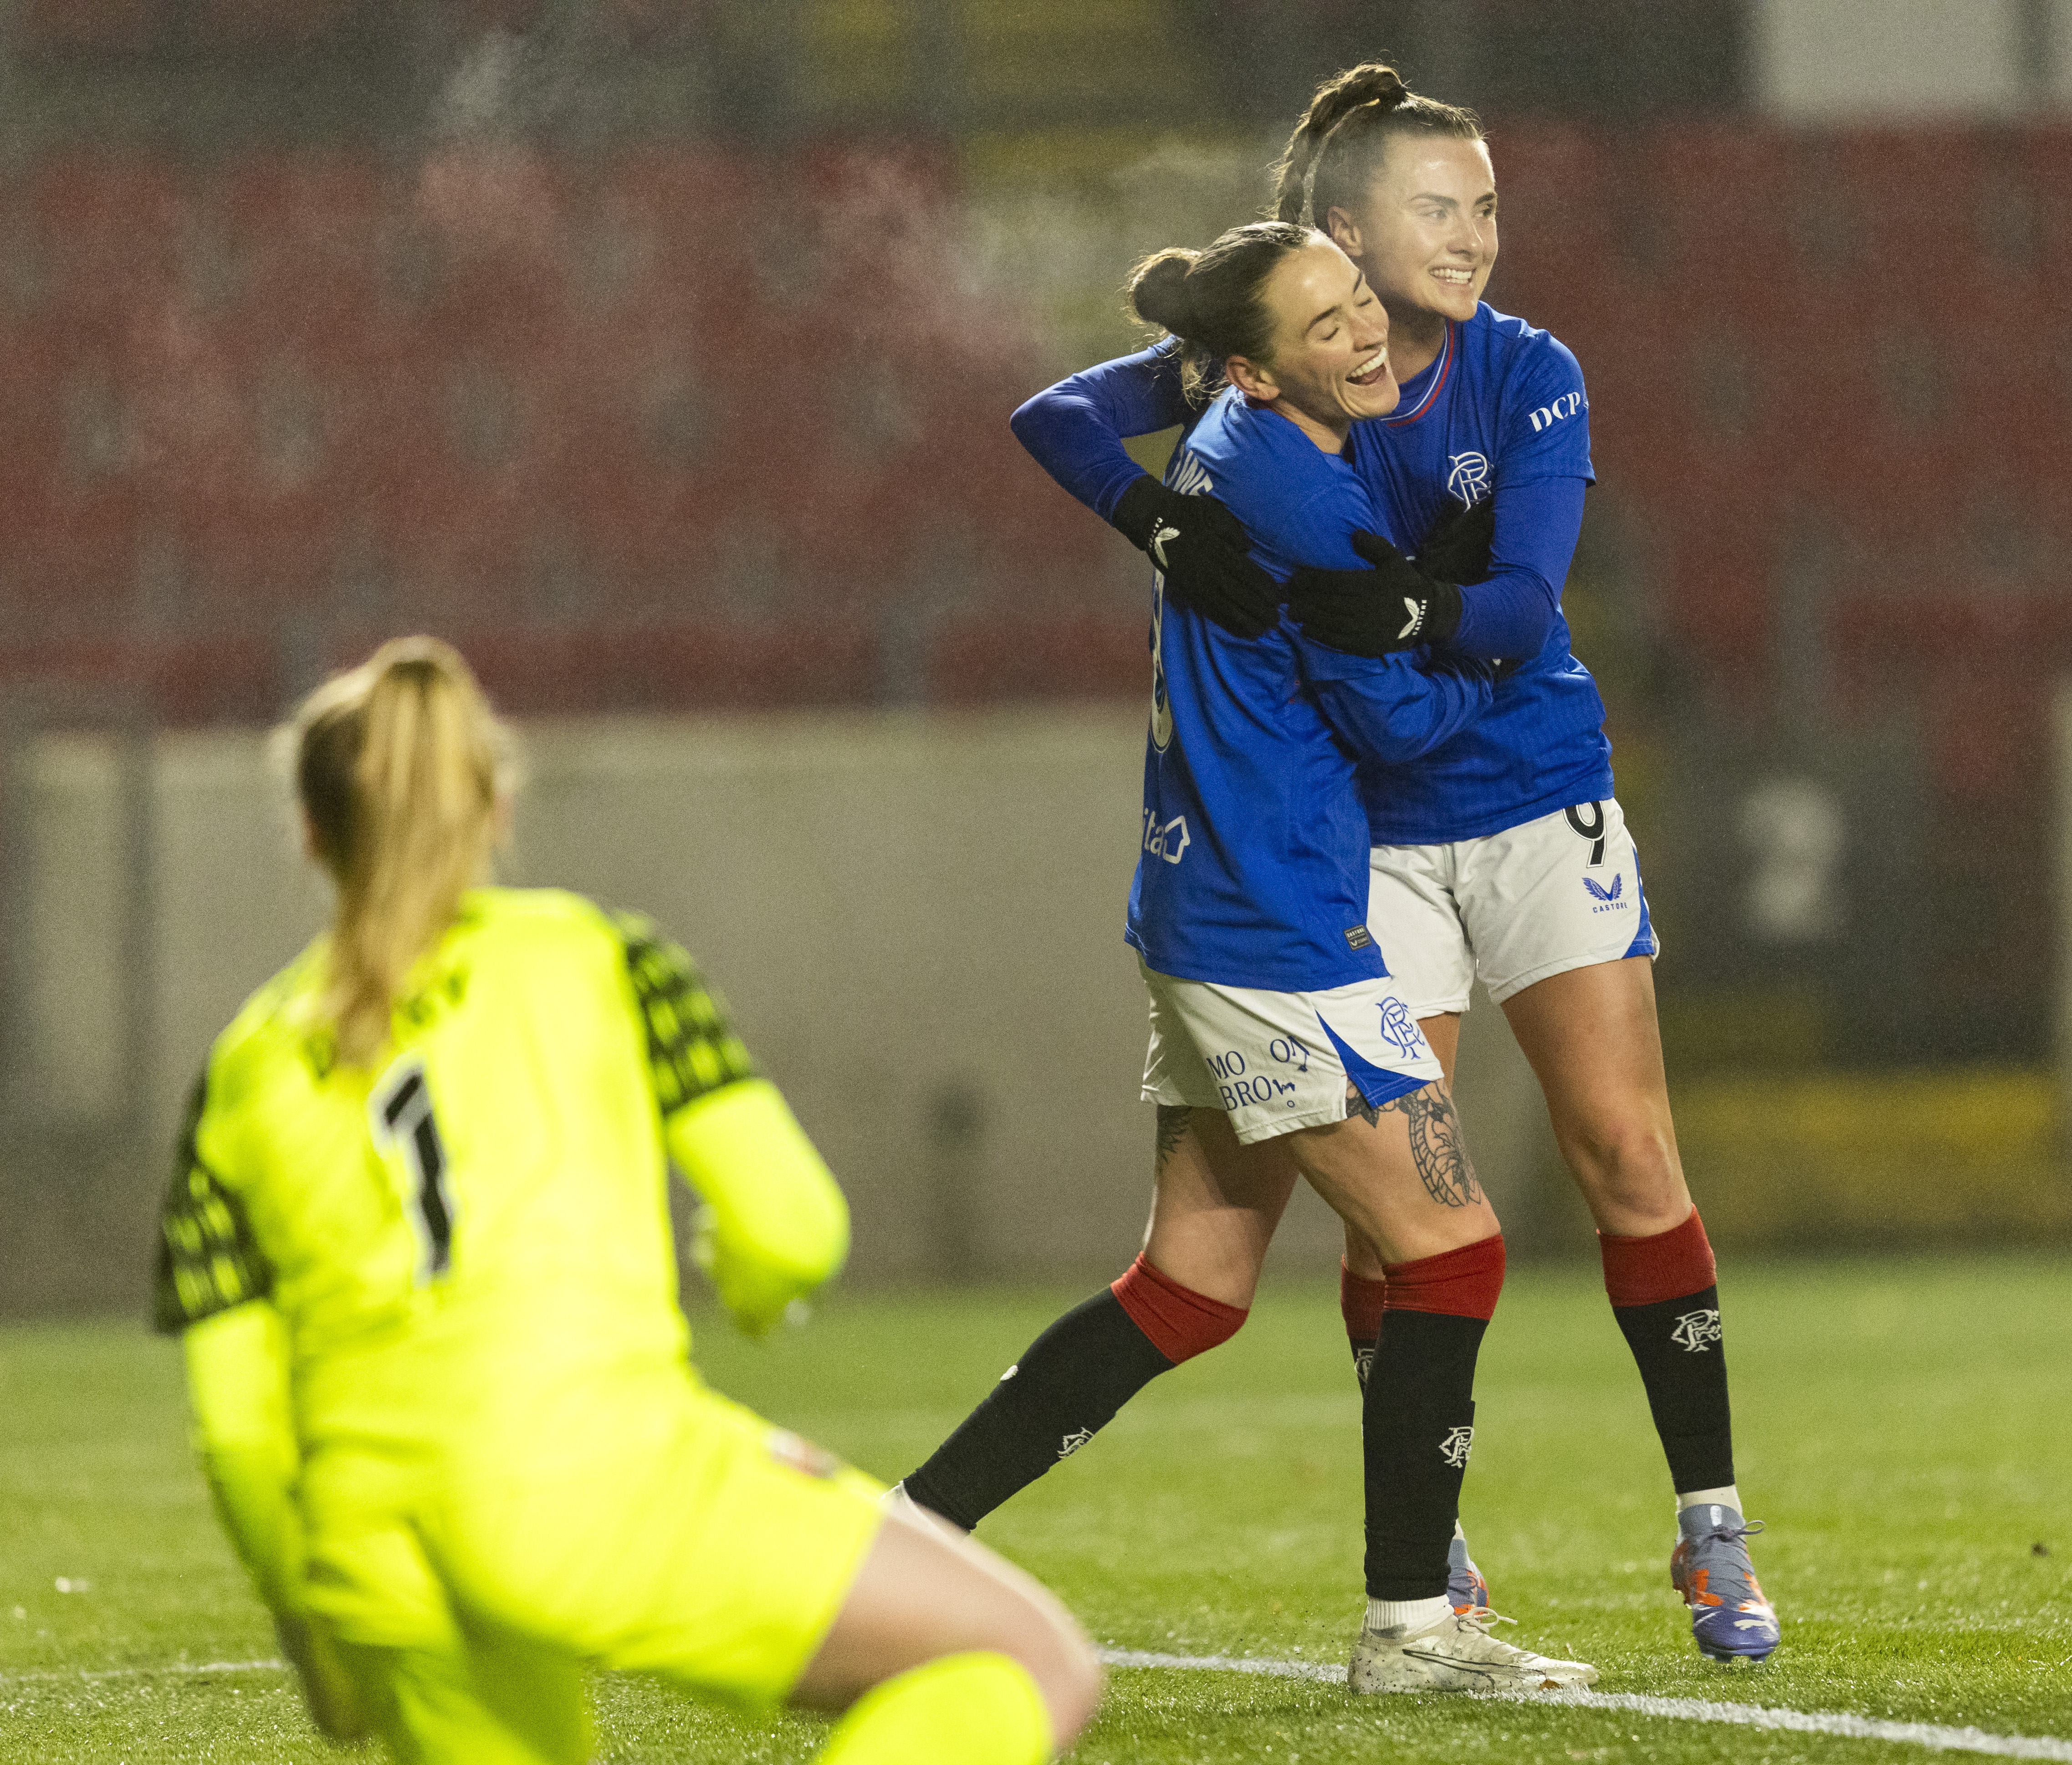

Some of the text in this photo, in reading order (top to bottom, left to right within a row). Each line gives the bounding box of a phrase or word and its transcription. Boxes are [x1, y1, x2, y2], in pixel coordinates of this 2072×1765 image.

[1529, 392, 1581, 432] DCP
[1562, 800, 1607, 868] 9
[1592, 902, 1628, 913] CASTORE
